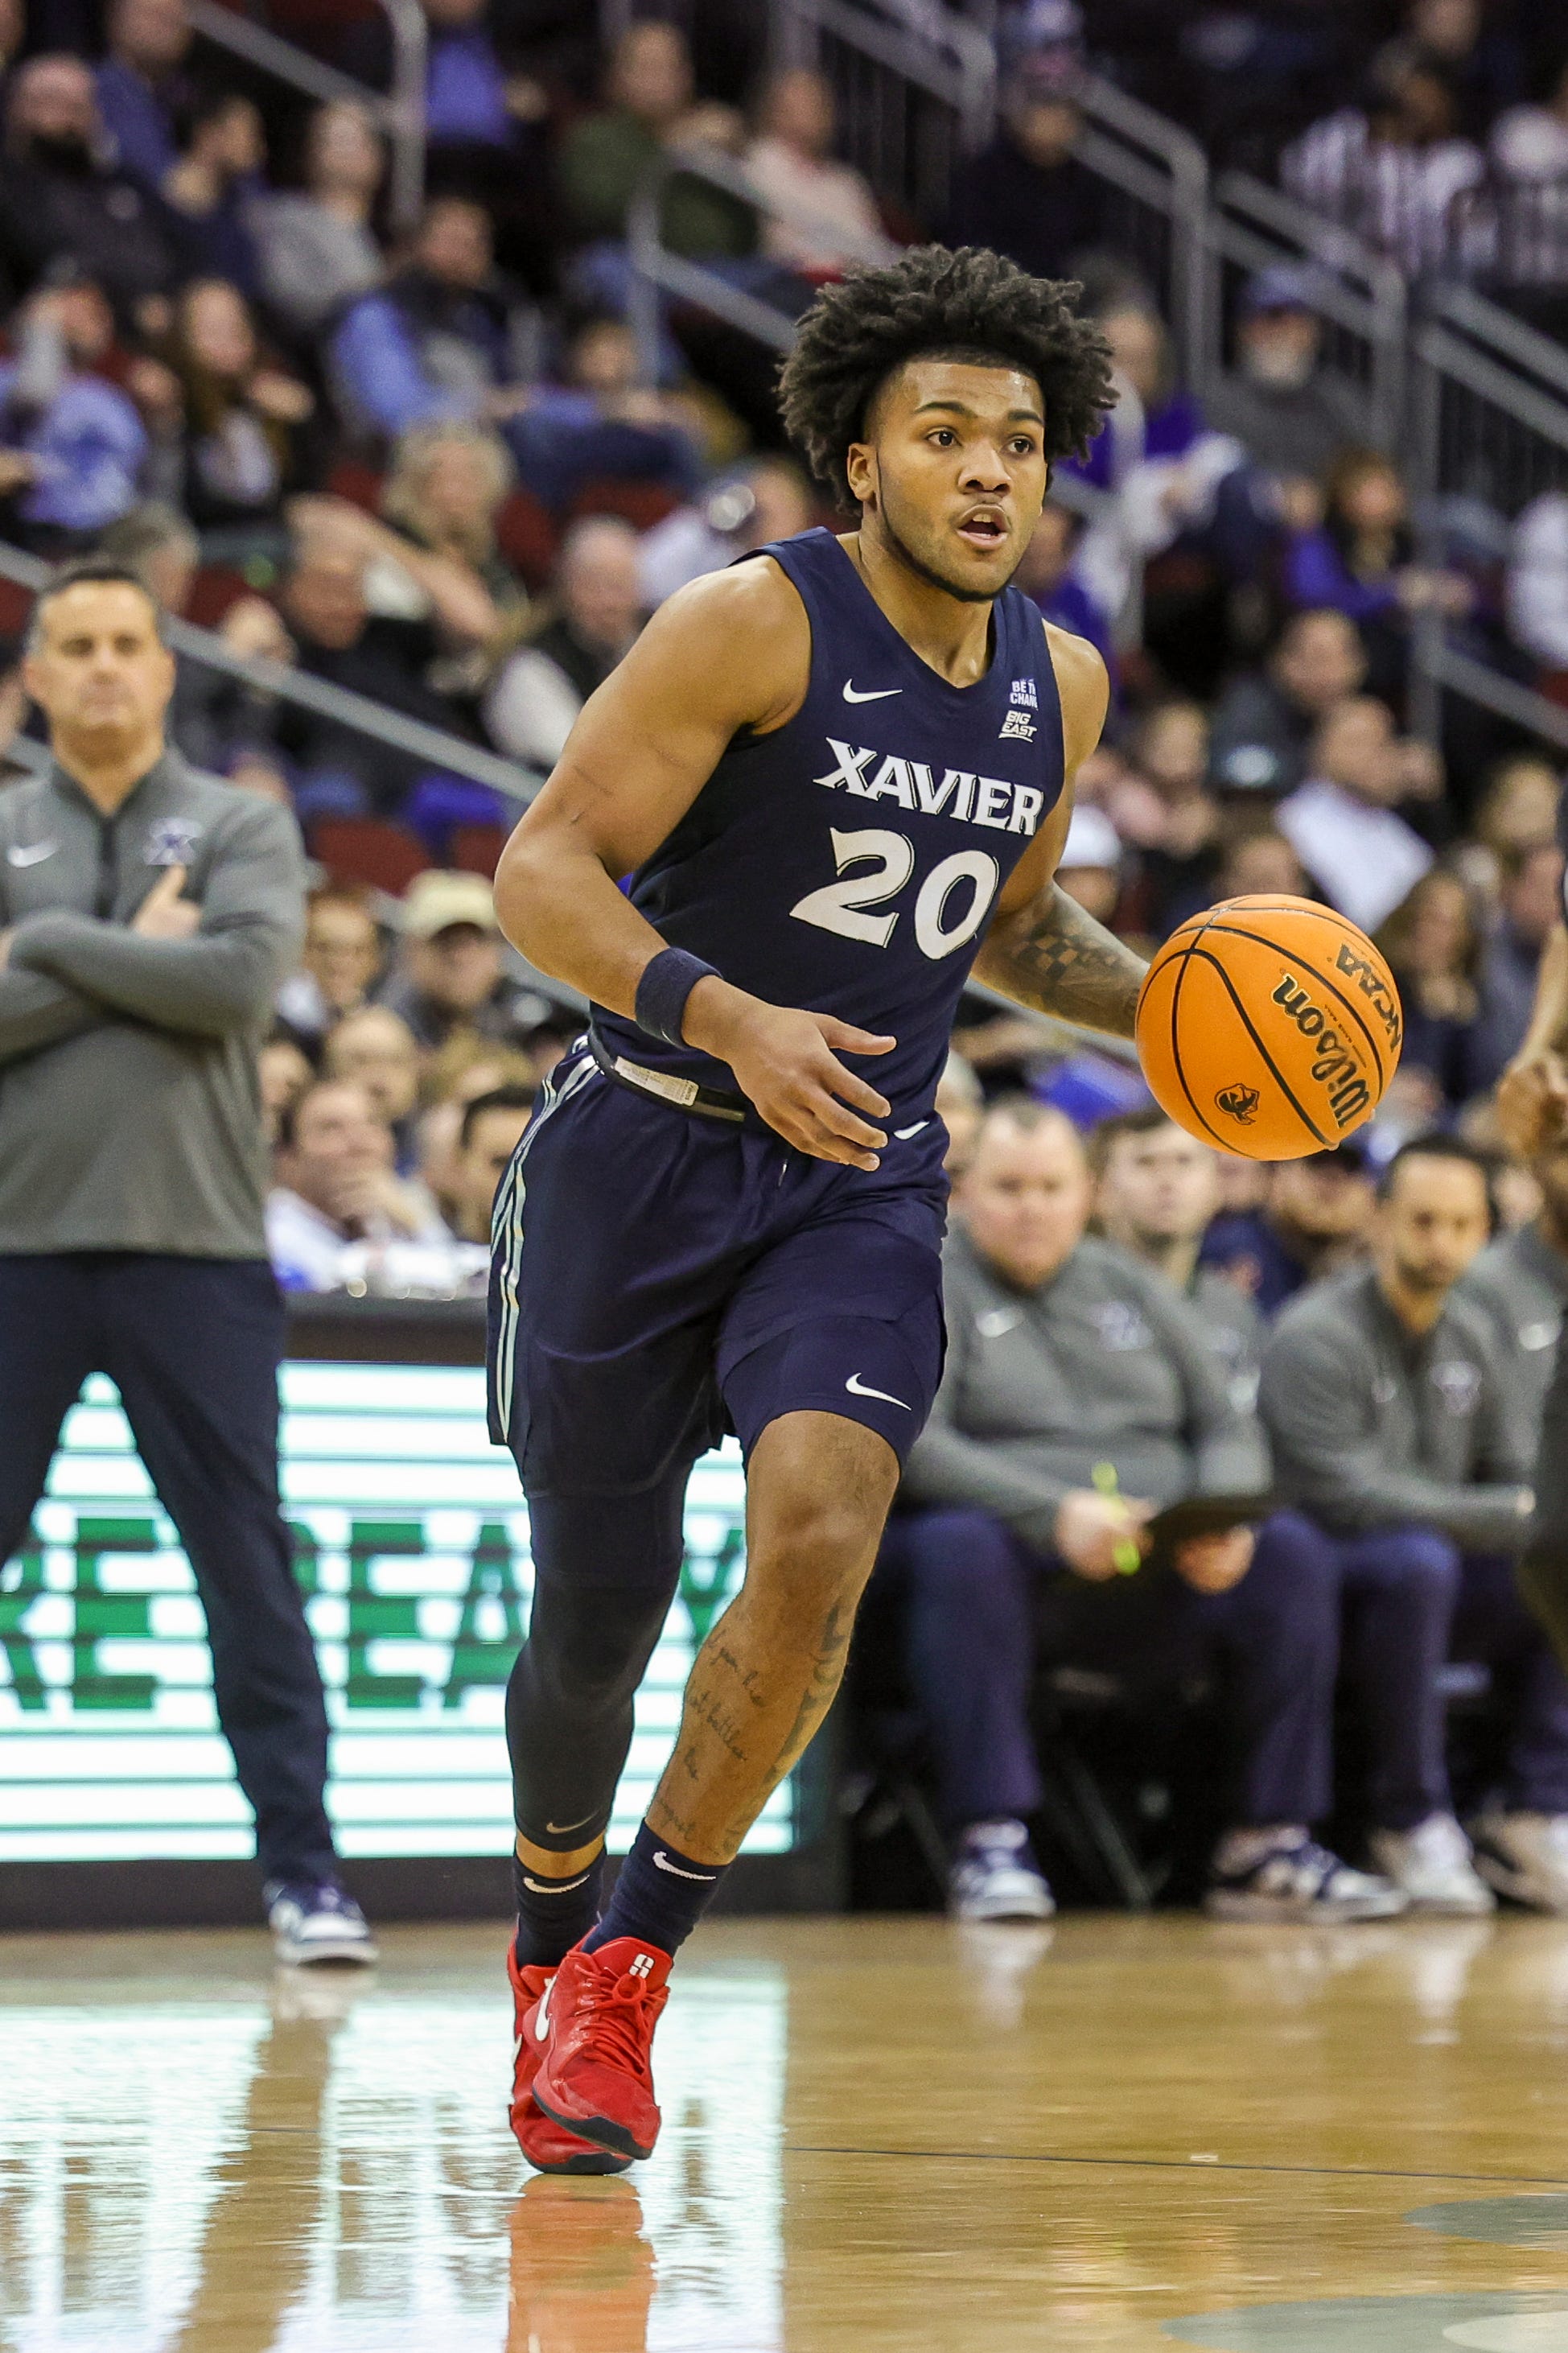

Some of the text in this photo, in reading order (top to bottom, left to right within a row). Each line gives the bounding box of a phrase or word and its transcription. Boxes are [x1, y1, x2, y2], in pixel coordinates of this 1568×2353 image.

[1001, 721, 1038, 737] EAST
[1006, 710, 1031, 724] BIG
[1011, 681, 1027, 693] BE
[813, 736, 1044, 836] XAVIER
[788, 827, 999, 960] 20
[1335, 942, 1401, 1053] NCAA
[1270, 973, 1370, 1129] Wilson
